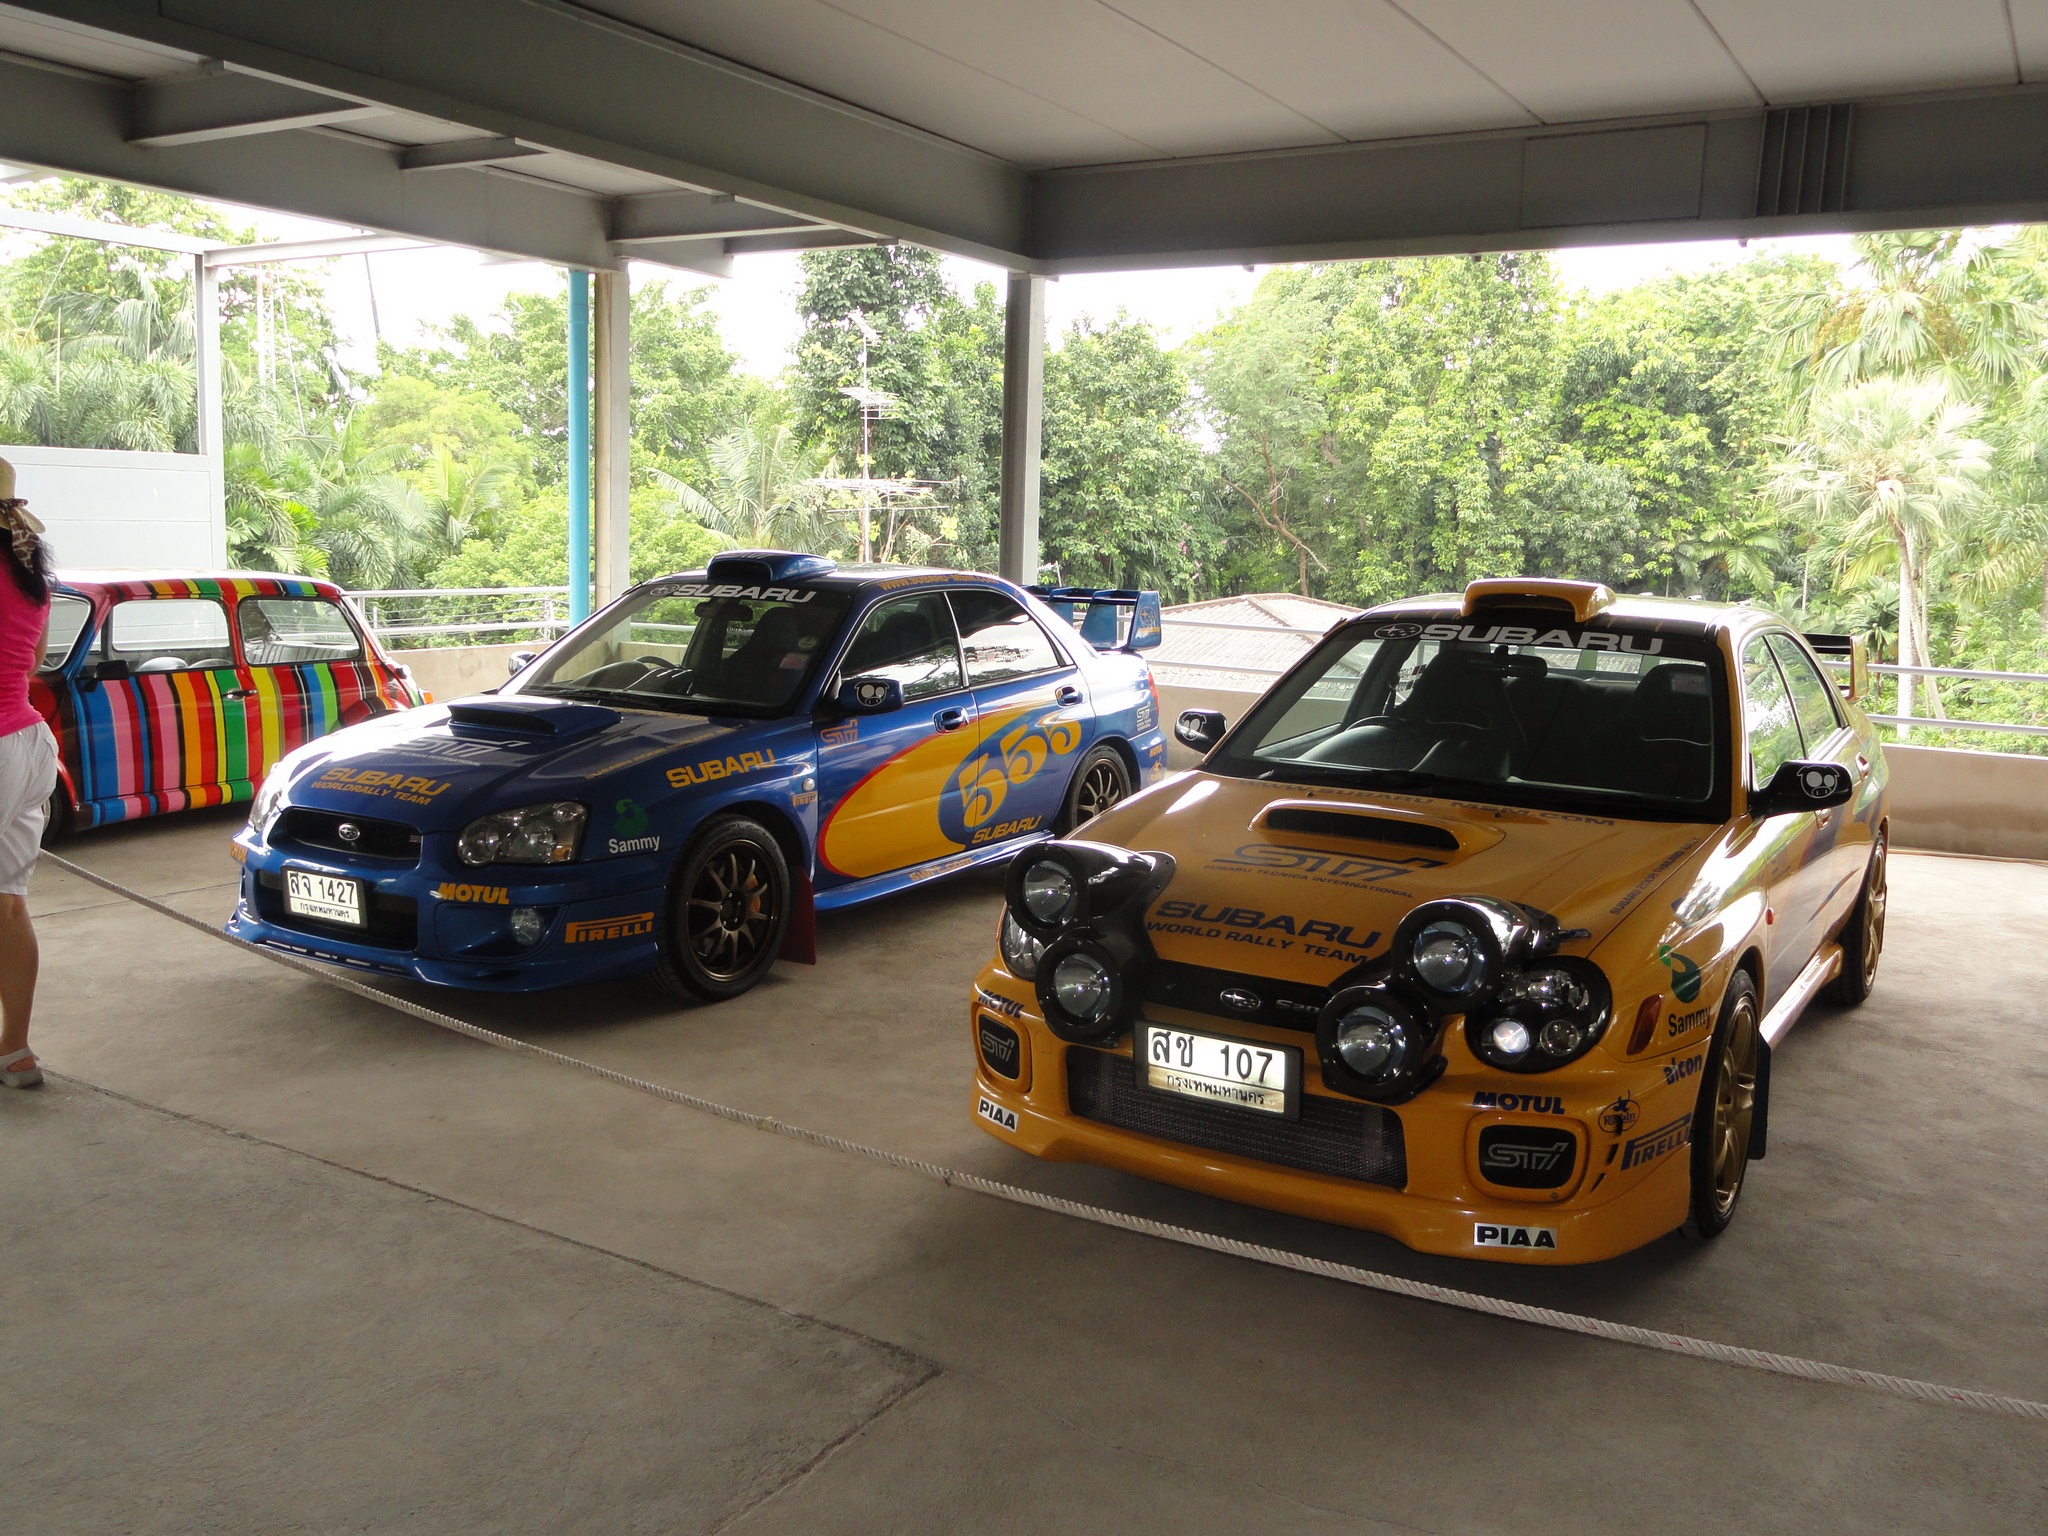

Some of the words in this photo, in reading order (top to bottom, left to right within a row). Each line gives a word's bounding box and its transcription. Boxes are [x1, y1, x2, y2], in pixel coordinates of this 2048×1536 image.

[673, 584, 817, 603] SUBARU
[1420, 624, 1662, 654] SUBARU
[320, 767, 452, 797] SUBARU
[666, 748, 775, 788] SUBARU
[958, 711, 1081, 828] 555
[394, 791, 432, 806] TEAM
[609, 836, 660, 854] Sammy
[972, 815, 1042, 844] SUBARU
[289, 873, 311, 897] สจ
[319, 878, 354, 904] 1427
[438, 882, 510, 905] MOTUL
[1203, 864, 1251, 873] SUBARU
[1257, 869, 1308, 880] TECNICA
[1312, 877, 1414, 898] INTERNATIONAL
[565, 911, 655, 943] PIRELLI
[1156, 900, 1381, 949] SUBARU
[1147, 921, 1221, 938] WORLD
[1224, 931, 1295, 950] RALLY
[1303, 943, 1369, 964] TEAM
[978, 989, 1024, 1019] MOTUL
[1668, 1006, 1710, 1037] Sammy
[1221, 1045, 1273, 1083] 107
[1664, 1054, 1702, 1085] alcon
[1167, 1073, 1265, 1105] กรุงเทพมหานคร
[1473, 1091, 1565, 1115] MOTUL
[979, 1099, 1015, 1130] PIAA
[1621, 1112, 1693, 1171] PIRELLI
[1476, 1226, 1556, 1249] PIAA
